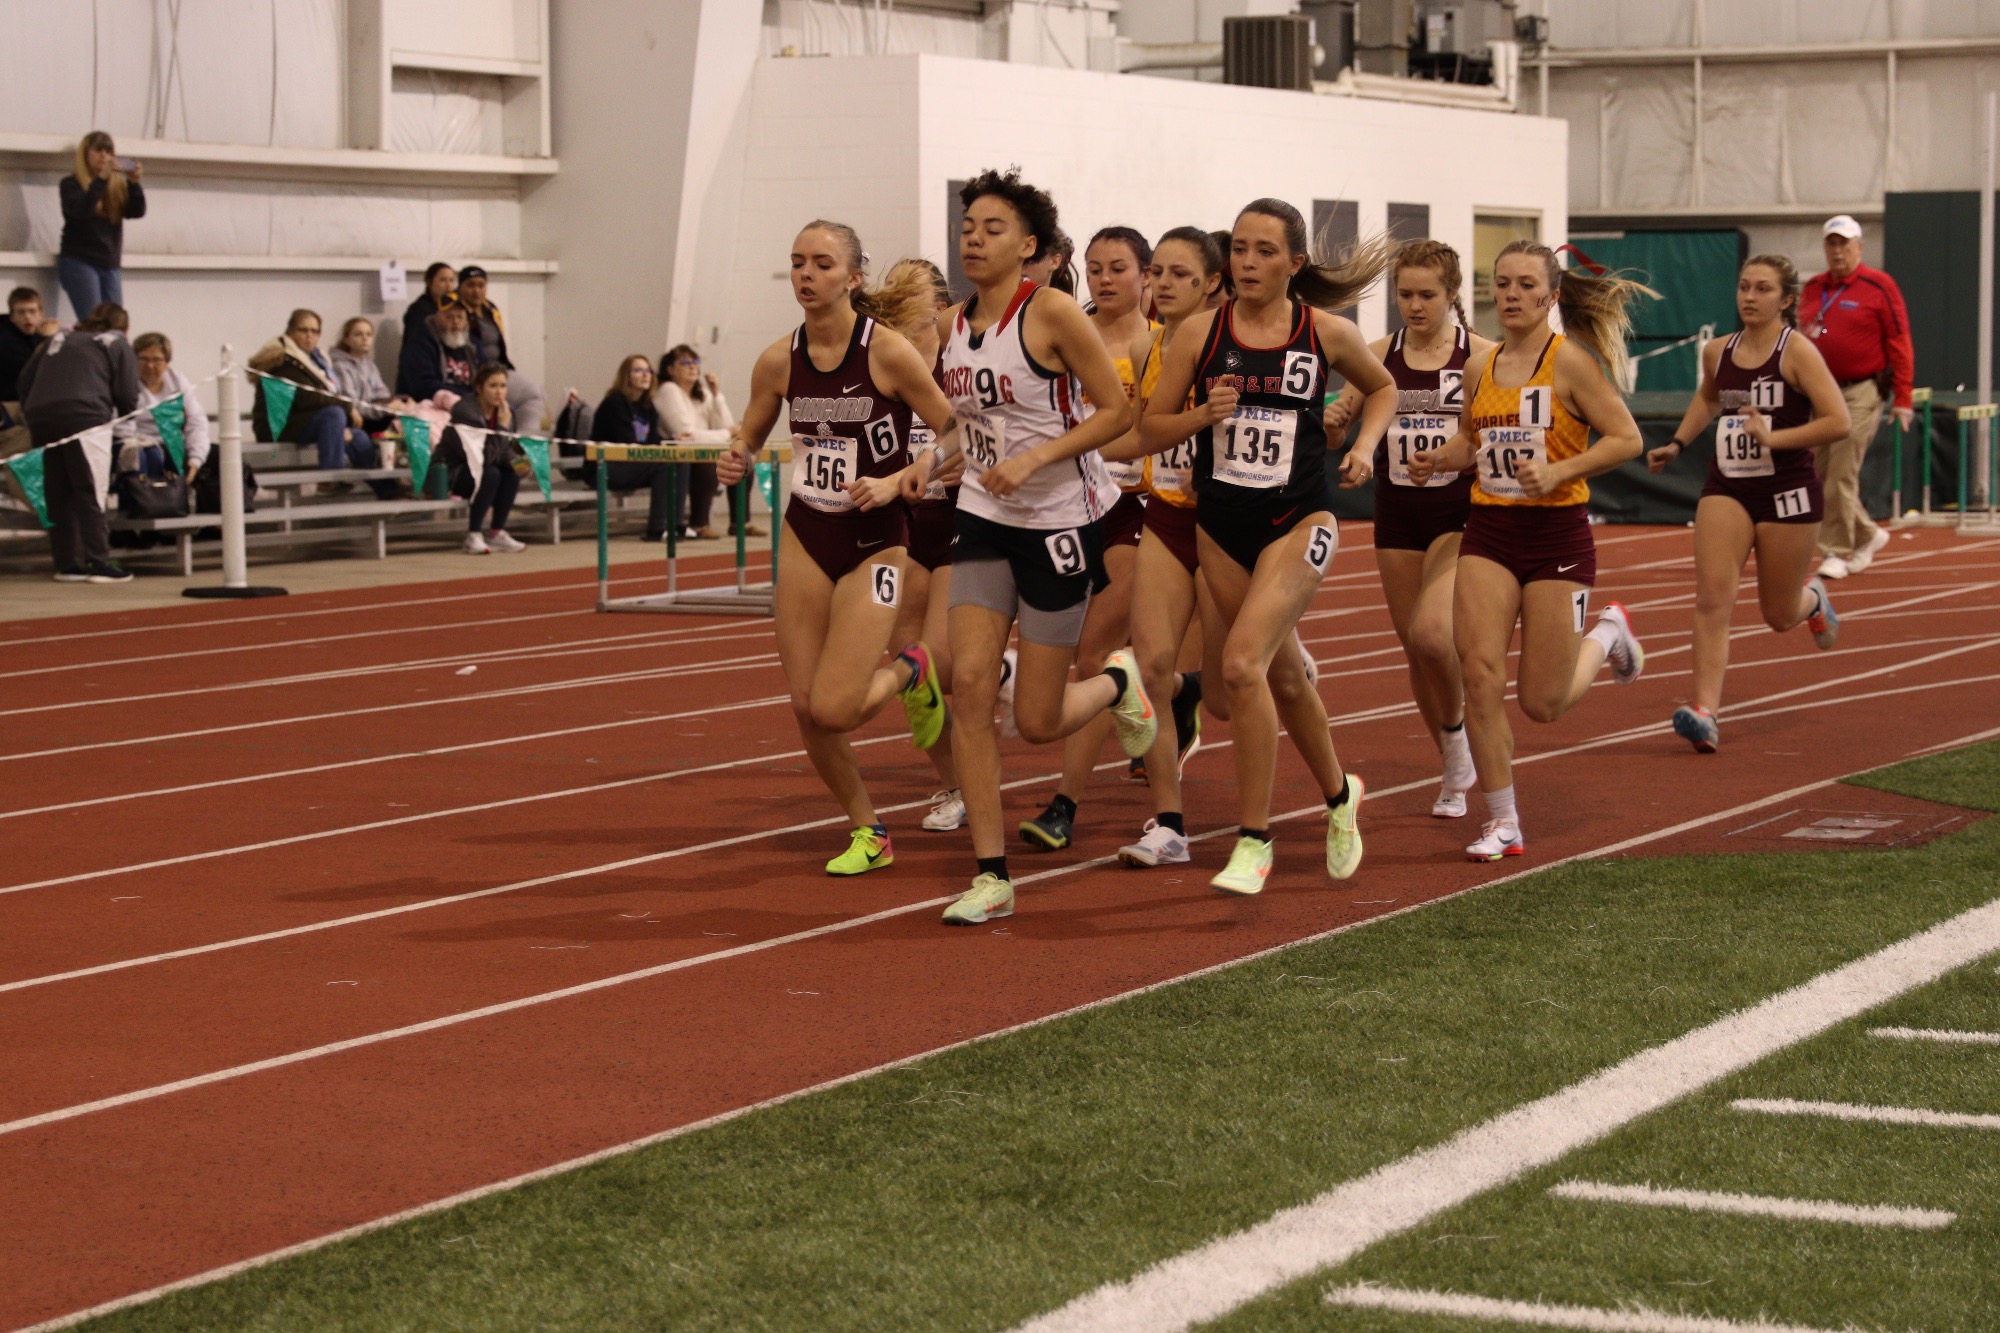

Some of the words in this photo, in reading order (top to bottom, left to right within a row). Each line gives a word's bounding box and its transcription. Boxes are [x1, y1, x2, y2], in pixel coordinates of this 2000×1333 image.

[976, 368, 997, 407] 9
[1247, 376, 1260, 392] &
[1287, 356, 1312, 394] 5
[1443, 372, 1463, 404] 2
[790, 397, 874, 422] CONCORD
[1525, 389, 1540, 424] 1
[1754, 383, 1774, 405] 11
[1244, 407, 1283, 422] MEC
[1412, 418, 1445, 428] MEC
[815, 438, 846, 451] MEC
[871, 420, 894, 456] 6
[909, 433, 928, 443] EC
[966, 423, 997, 468] 185
[1225, 425, 1282, 466] 135
[1499, 431, 1531, 442] MEC
[803, 453, 846, 492] 156
[1226, 469, 1273, 481] CHAMPIONSHIP
[804, 495, 842, 507] CHAMPIONSHIP
[1777, 491, 1802, 515] 11
[1054, 534, 1081, 573] 9
[1309, 527, 1332, 567] 5
[875, 567, 895, 602] 6
[1576, 593, 1585, 628] 1
